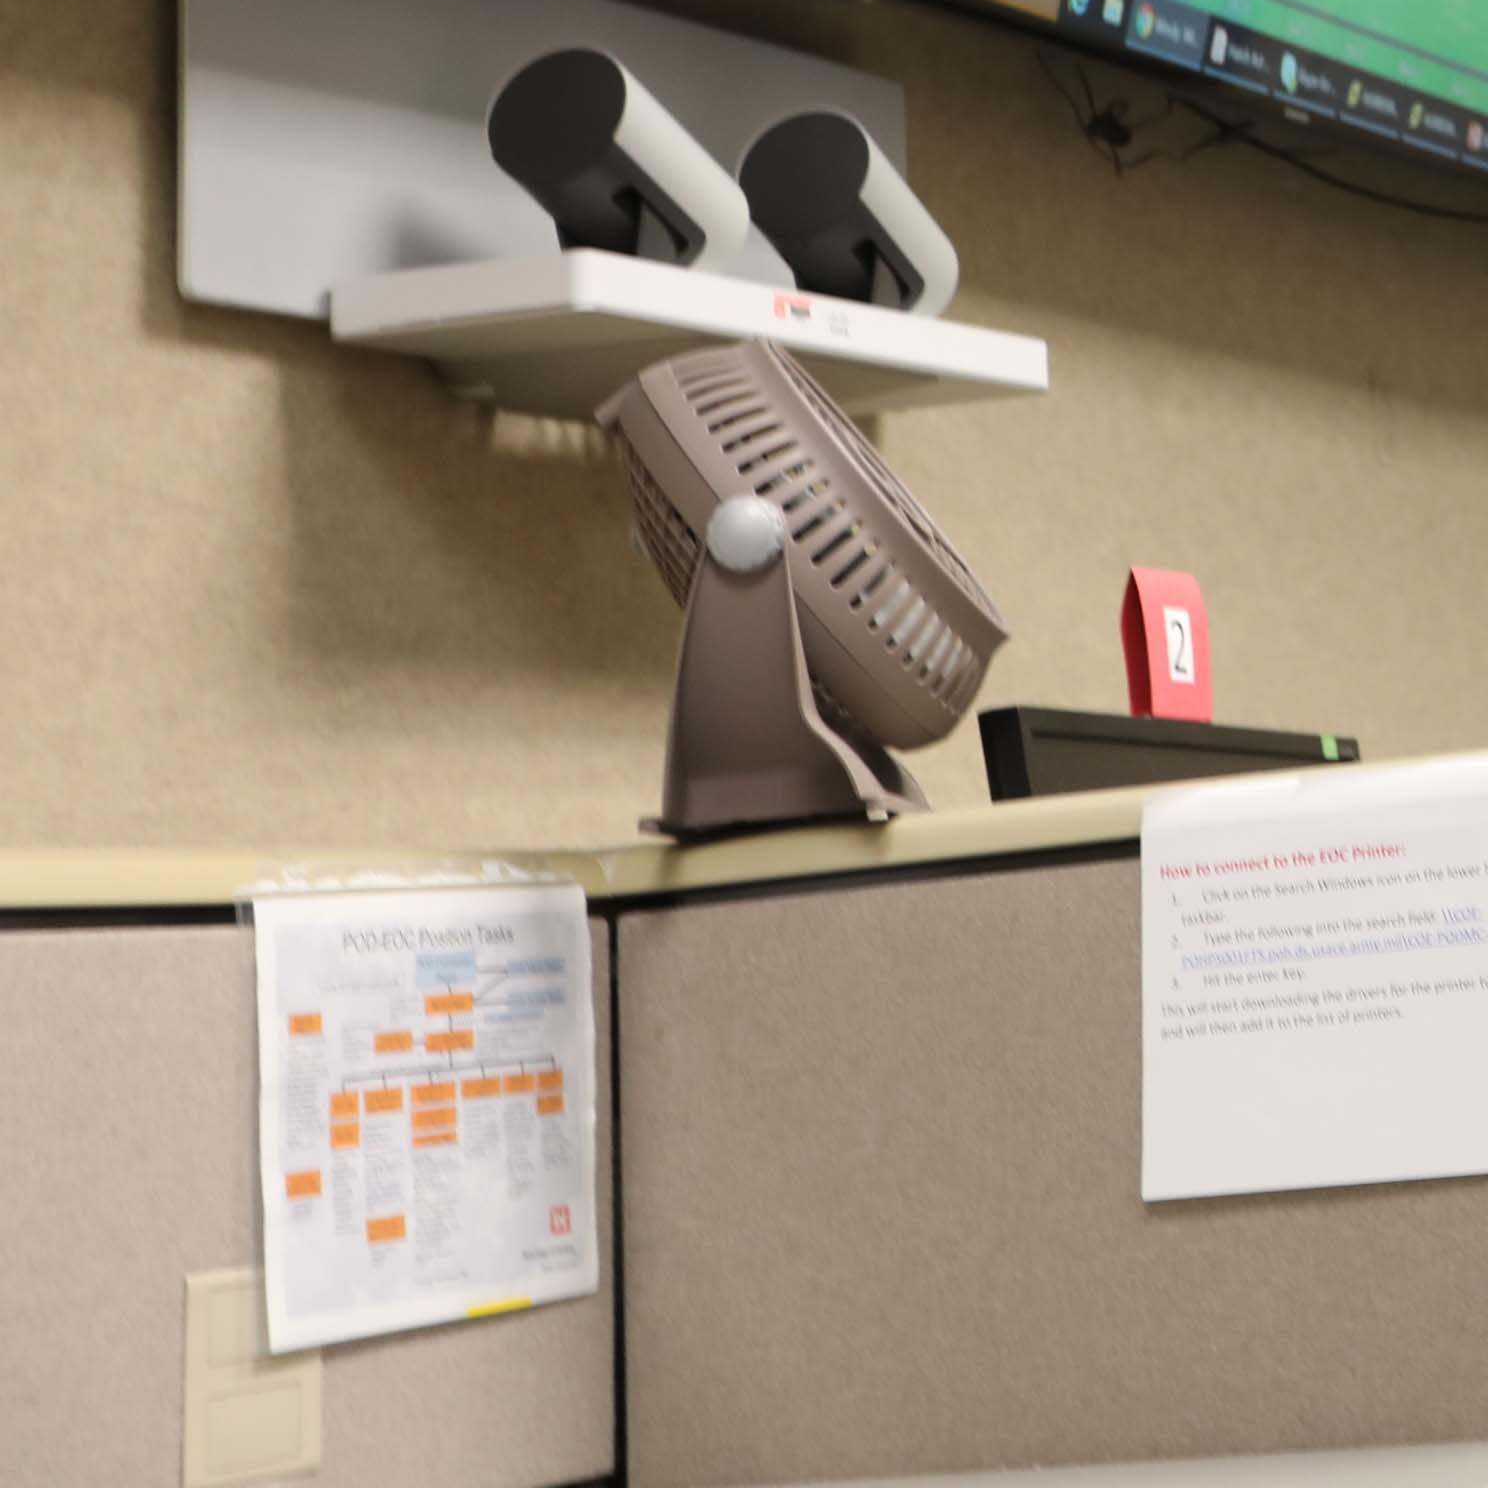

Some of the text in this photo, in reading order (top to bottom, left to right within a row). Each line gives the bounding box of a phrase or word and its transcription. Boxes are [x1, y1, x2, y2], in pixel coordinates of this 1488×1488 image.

[1171, 619, 1187, 674] 2
[1159, 861, 1190, 881] How
[1195, 860, 1210, 878] to
[1214, 853, 1268, 876] connect
[1273, 852, 1288, 869] to
[1291, 848, 1315, 867] the
[1319, 845, 1348, 865] EOC
[1201, 886, 1229, 904] Click
[1232, 886, 1249, 901] on
[1252, 882, 1271, 899] the
[1273, 877, 1314, 897] Search
[1316, 871, 1373, 893] Windows
[1375, 870, 1401, 887] icon
[1403, 869, 1420, 884] on
[1423, 864, 1443, 882] the
[1446, 861, 1480, 880] lower
[476, 920, 514, 945] Tasks
[1203, 929, 1231, 949] Type
[1234, 926, 1254, 942] the
[1256, 919, 1313, 943] following
[1315, 917, 1339, 934] into
[1343, 915, 1362, 931] the
[1366, 911, 1405, 930] search
[1223, 969, 1242, 985] the
[1246, 966, 1279, 983] enter
[1160, 1001, 1183, 1018] This
[1210, 997, 1239, 1014] start
[1241, 988, 1319, 1014] downloading
[1322, 986, 1343, 1003] the
[1345, 982, 1387, 1001] drivers
[1390, 980, 1406, 998] for
[1410, 977, 1431, 996] the
[1433, 973, 1475, 996] printer
[1160, 1023, 1183, 1041] and
[1209, 1018, 1237, 1036] then
[1240, 1016, 1262, 1033] add
[1277, 1014, 1291, 1029] to
[1293, 1010, 1313, 1028] the
[1315, 1008, 1334, 1025] list
